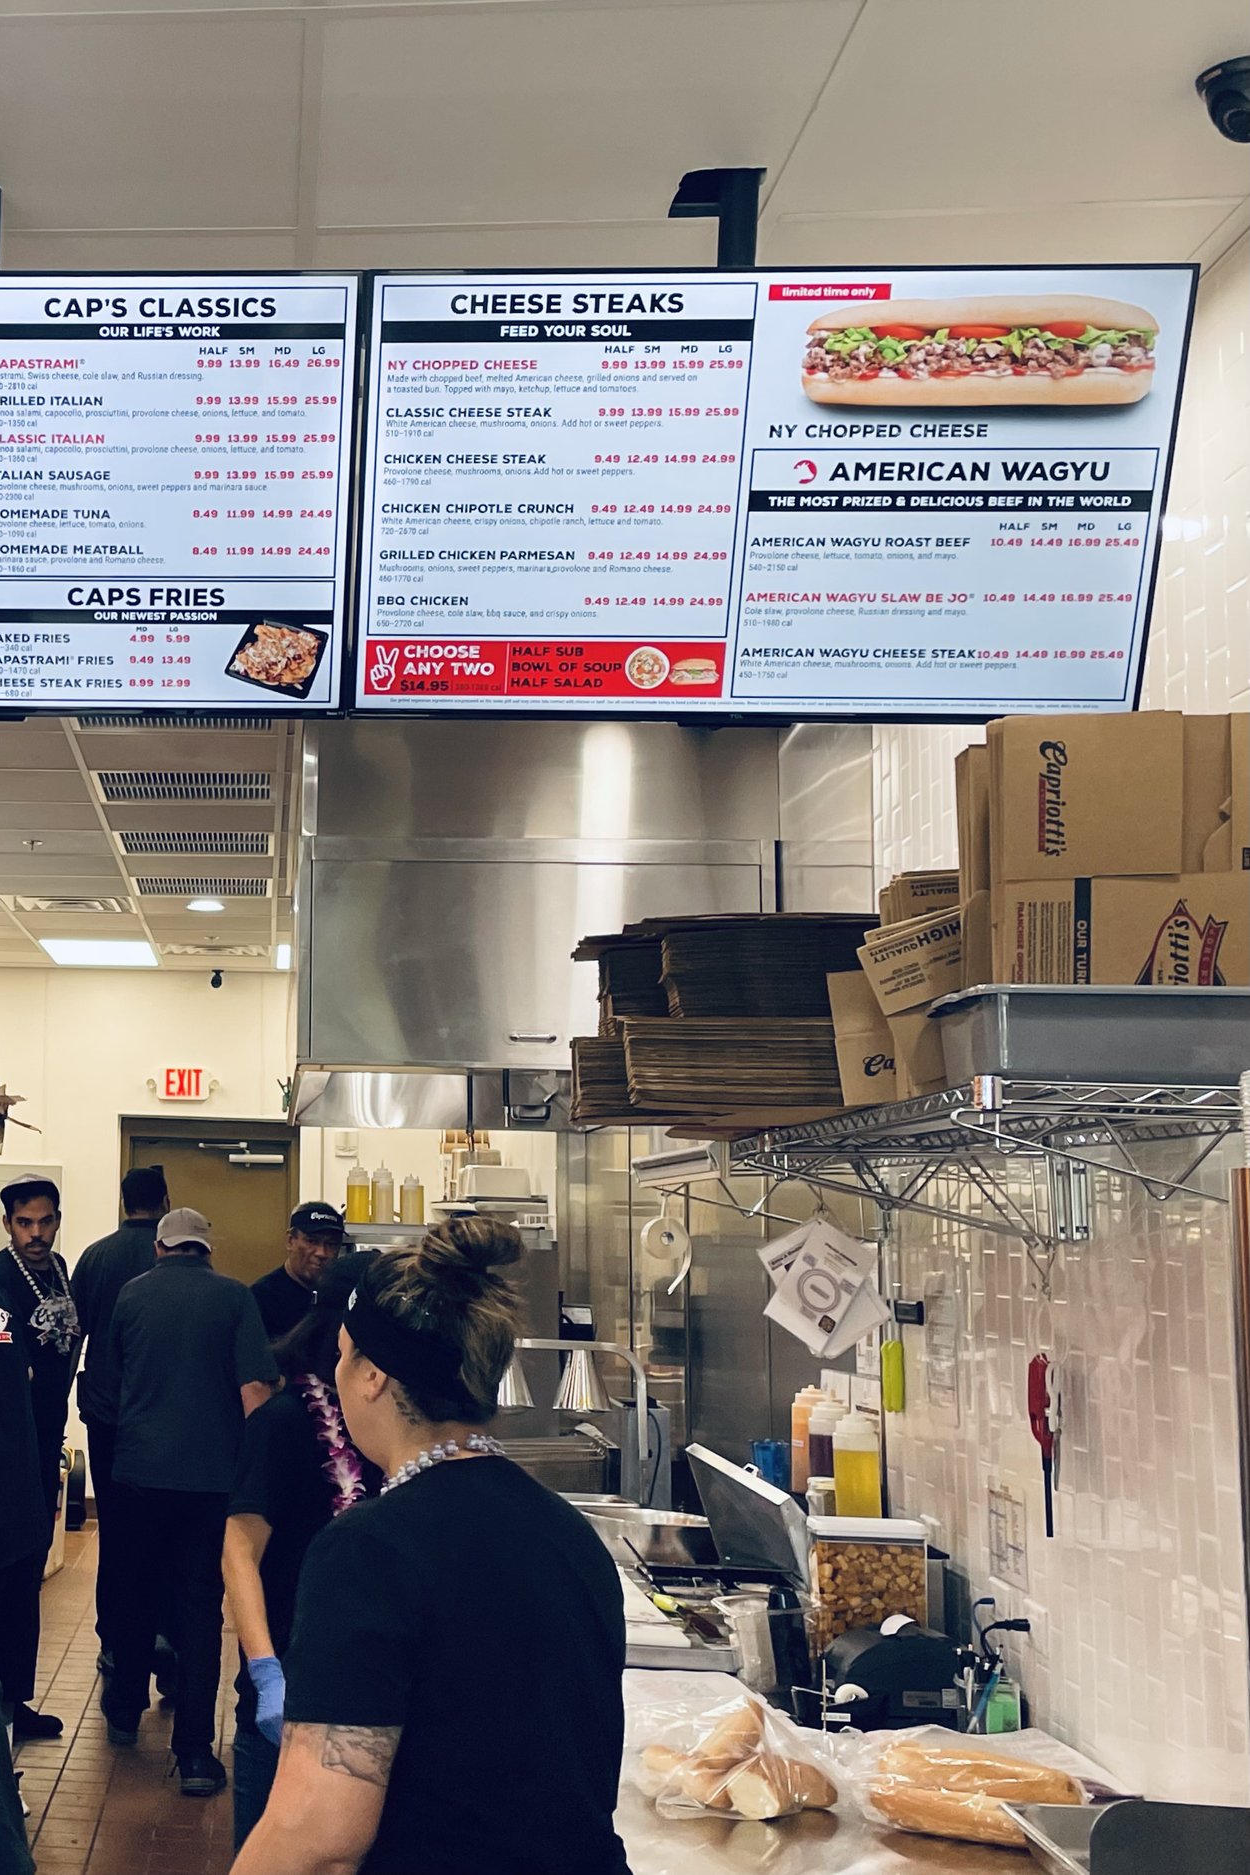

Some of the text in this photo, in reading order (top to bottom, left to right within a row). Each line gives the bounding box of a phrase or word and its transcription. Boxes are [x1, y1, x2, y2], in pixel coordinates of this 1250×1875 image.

[782, 287, 875, 299] limited time only
[44, 297, 276, 317] CAP'S CLASSICS
[451, 293, 684, 314] CHEESE STEAKS
[99, 327, 220, 337] OUR LIFE'S WORK
[500, 324, 631, 337] FEED YOUR SOUL
[605, 345, 733, 354] HALF SM MD LG
[388, 360, 537, 370] NY CHOPPED CHEESE
[601, 361, 743, 369] 9.99 13.99 15.99 25.99
[50, 396, 102, 406] ITALIAN
[829, 462, 1110, 481] AMERICAN WAGYU
[769, 496, 1131, 506] THE MOST PRIZED & DELICIOUS BEEF IN THE WORLD
[382, 504, 574, 514] CHICKEN CHIPOTLE CRUNCH
[67, 588, 225, 606] CAPS FRIES
[94, 612, 217, 621] OUR NEWEST PASSION
[34, 634, 70, 643] FRIES
[404, 645, 480, 659] CHOOSE
[403, 663, 494, 676] ANY TWO
[400, 680, 449, 692] $14.95
[1039, 741, 1068, 857] Capriotti's
[1077, 920, 1087, 948] OUR
[166, 1069, 202, 1096] EXIT
